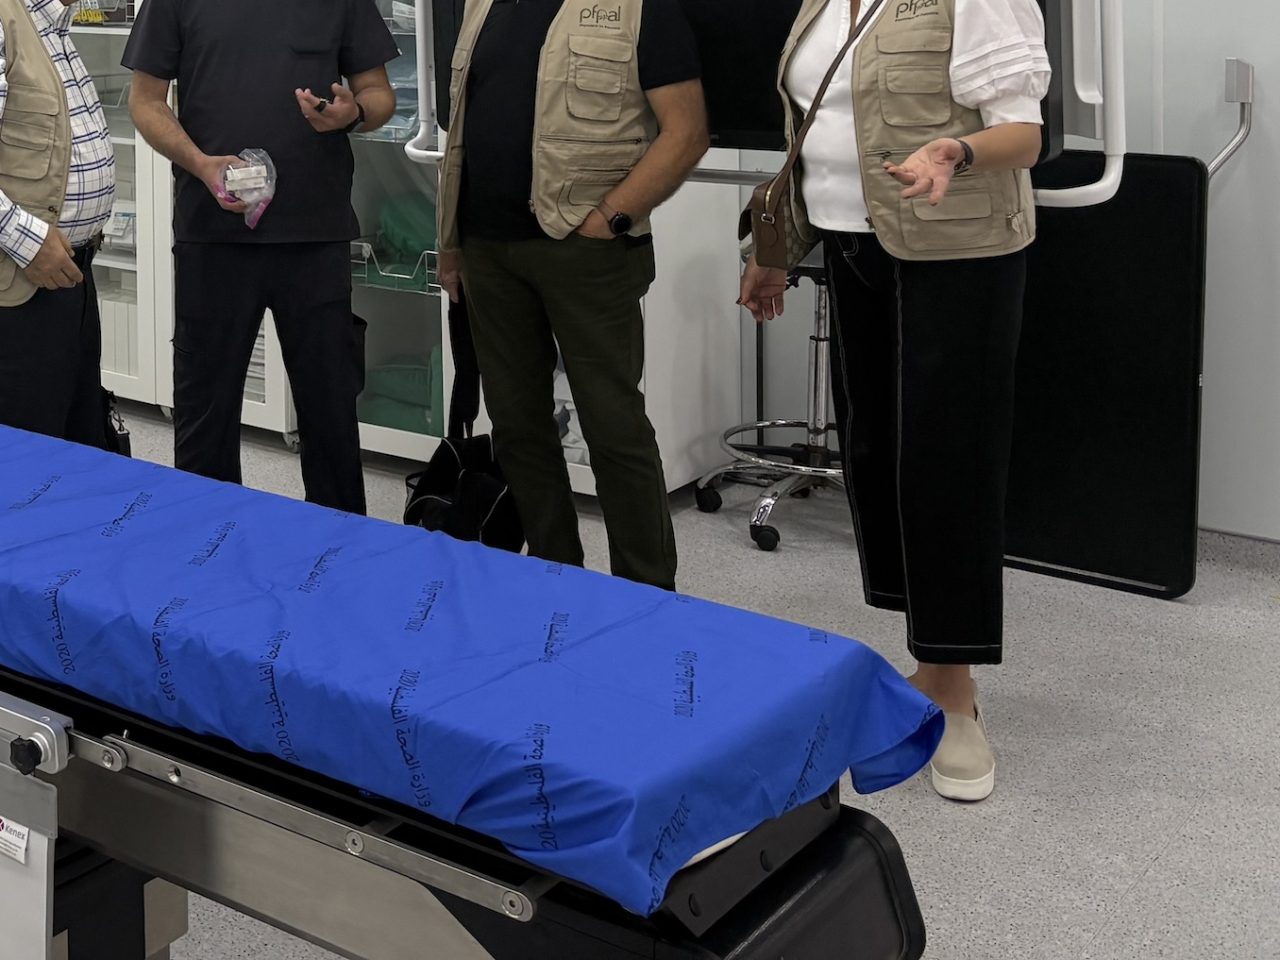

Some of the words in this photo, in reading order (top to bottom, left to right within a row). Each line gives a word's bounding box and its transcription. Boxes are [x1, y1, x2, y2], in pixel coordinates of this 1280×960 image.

[55, 642, 76, 675] 2020
[158, 669, 176, 701] وزارة
[258, 660, 288, 728] الفلسطينية
[275, 730, 300, 760] 2020
[396, 727, 421, 770] الصحة
[410, 773, 431, 807] وزارة
[524, 763, 555, 829] الفلسطينية
[538, 831, 558, 850] 20
